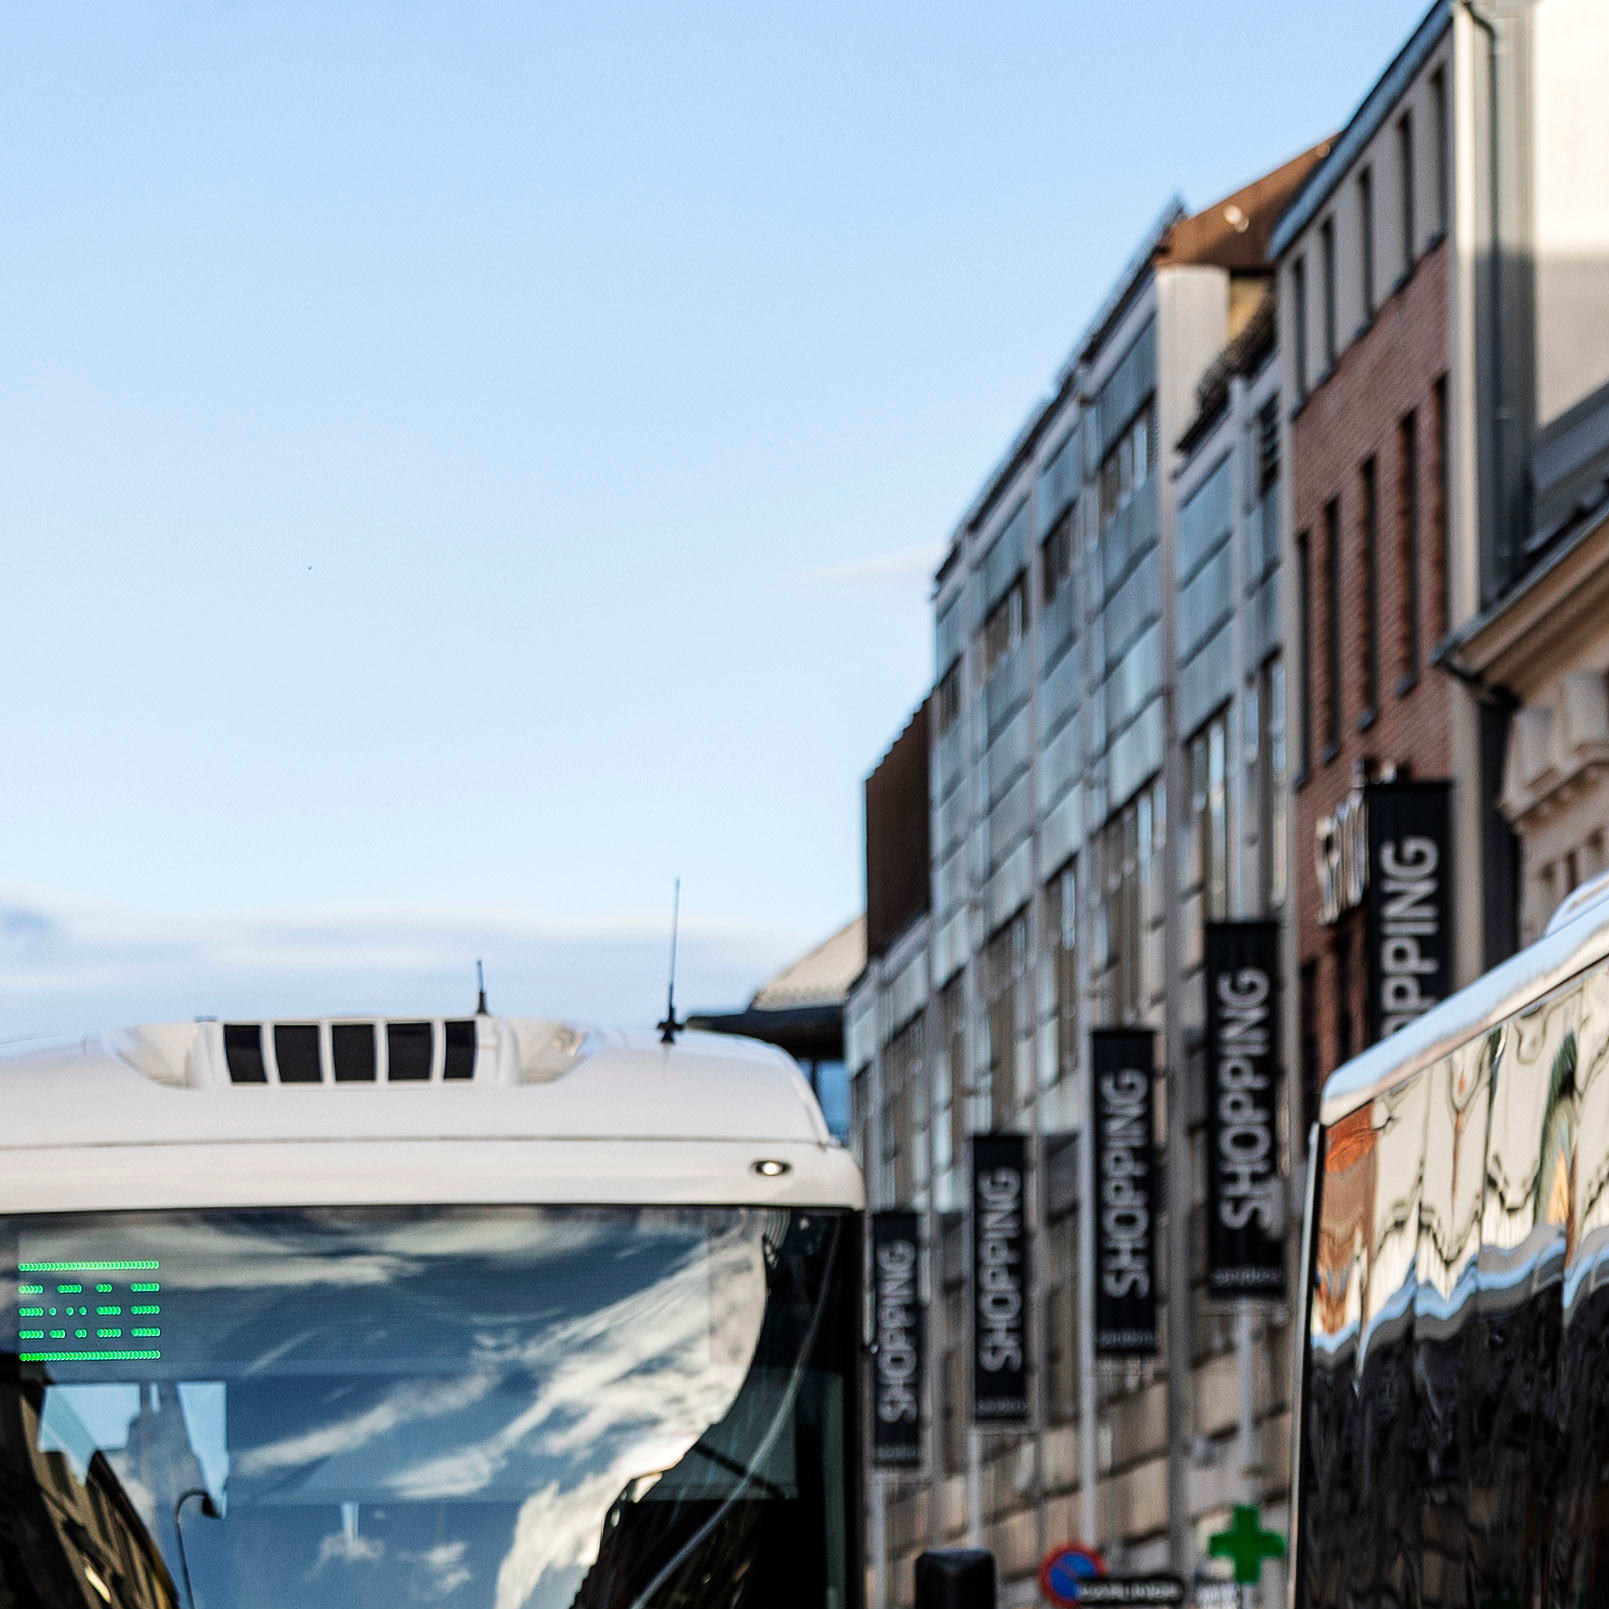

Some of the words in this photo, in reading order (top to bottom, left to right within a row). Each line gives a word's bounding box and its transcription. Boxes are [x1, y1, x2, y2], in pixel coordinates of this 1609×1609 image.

[1101, 1068, 1150, 1298] SHOPPING
[1217, 966, 1271, 1231] SHOPPING
[878, 1240, 917, 1423] SHOPPING
[978, 1166, 1022, 1371] SHOPPING
